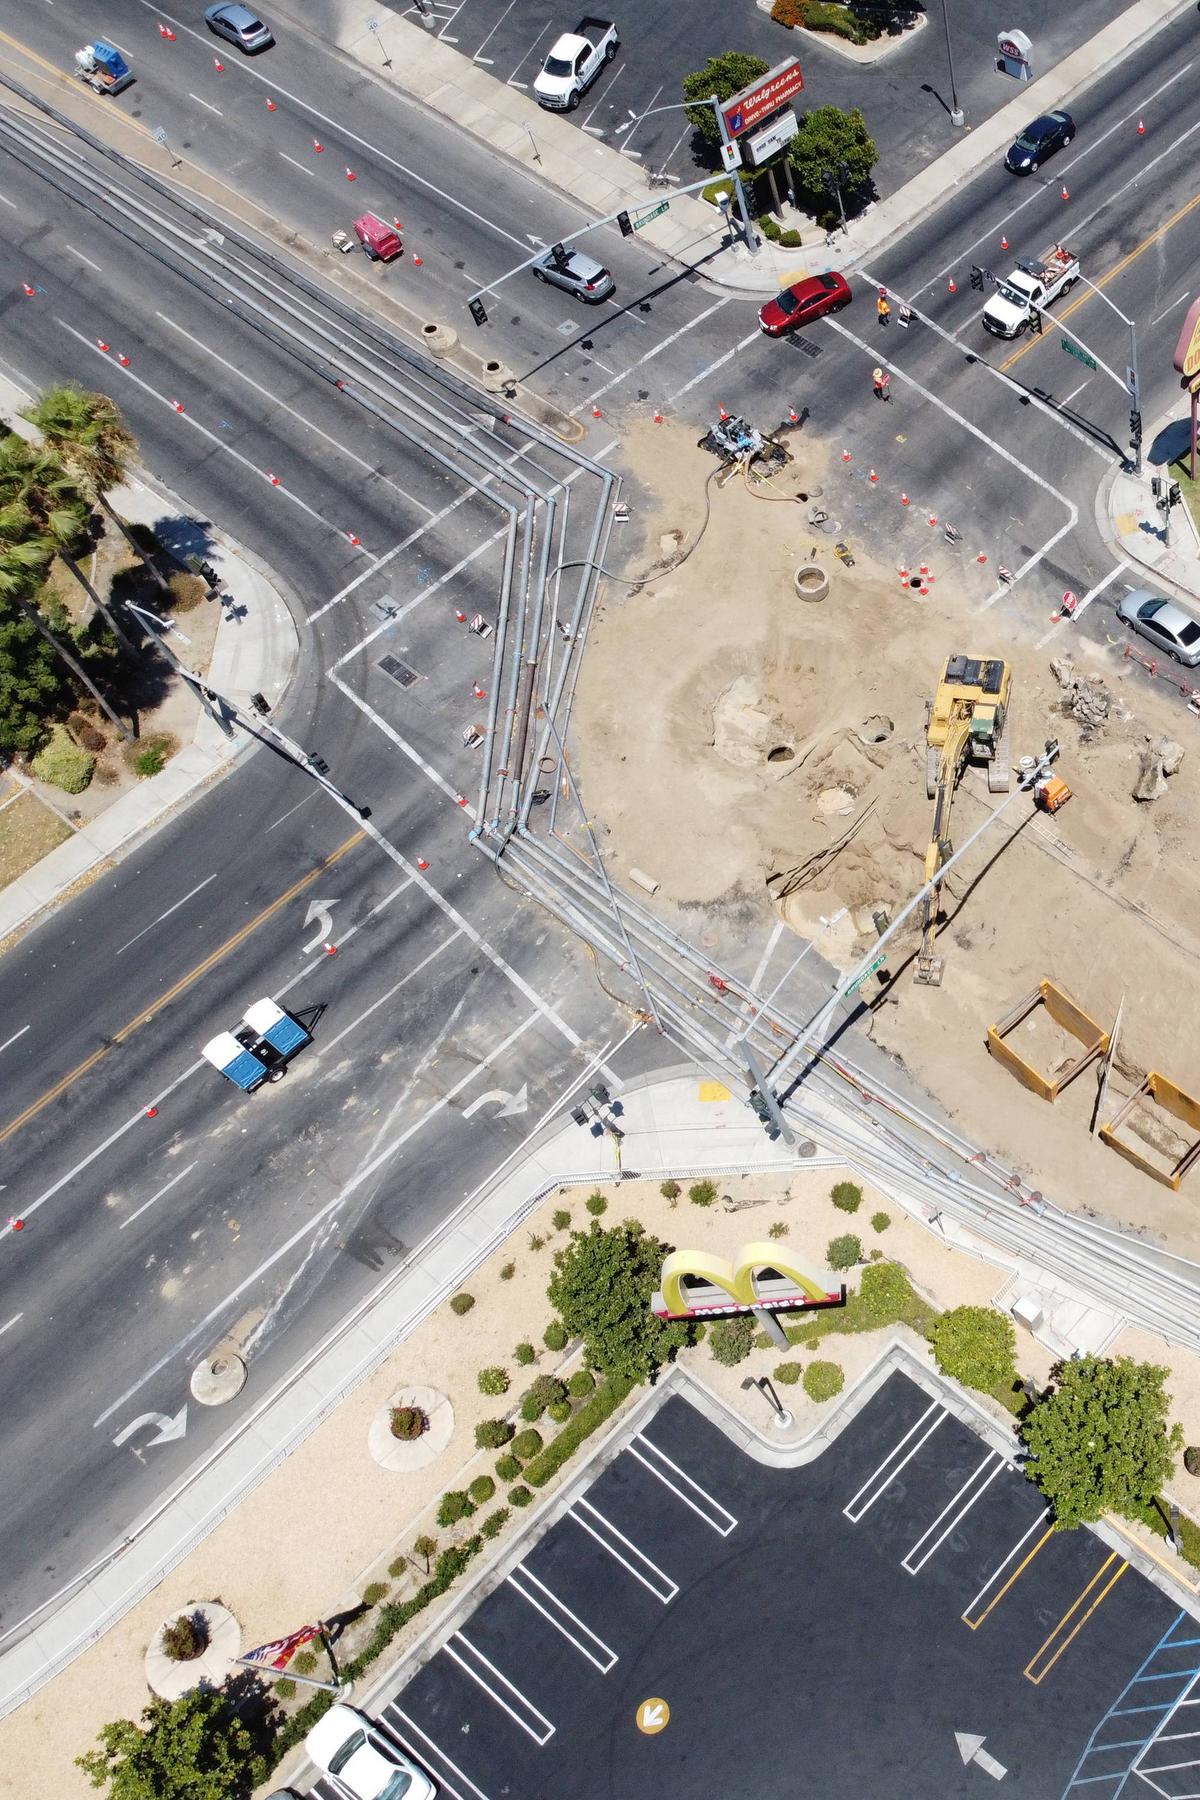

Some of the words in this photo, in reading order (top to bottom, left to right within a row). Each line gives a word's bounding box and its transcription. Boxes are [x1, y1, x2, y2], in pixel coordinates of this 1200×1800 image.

[1002, 43, 1019, 56] WSS
[743, 69, 800, 110] Walgreens
[744, 101, 775, 125] DRIVE-THRU
[775, 81, 802, 103] PHARMACY
[157, 133, 167, 142] 40
[694, 1299, 805, 1316] McDonald's
